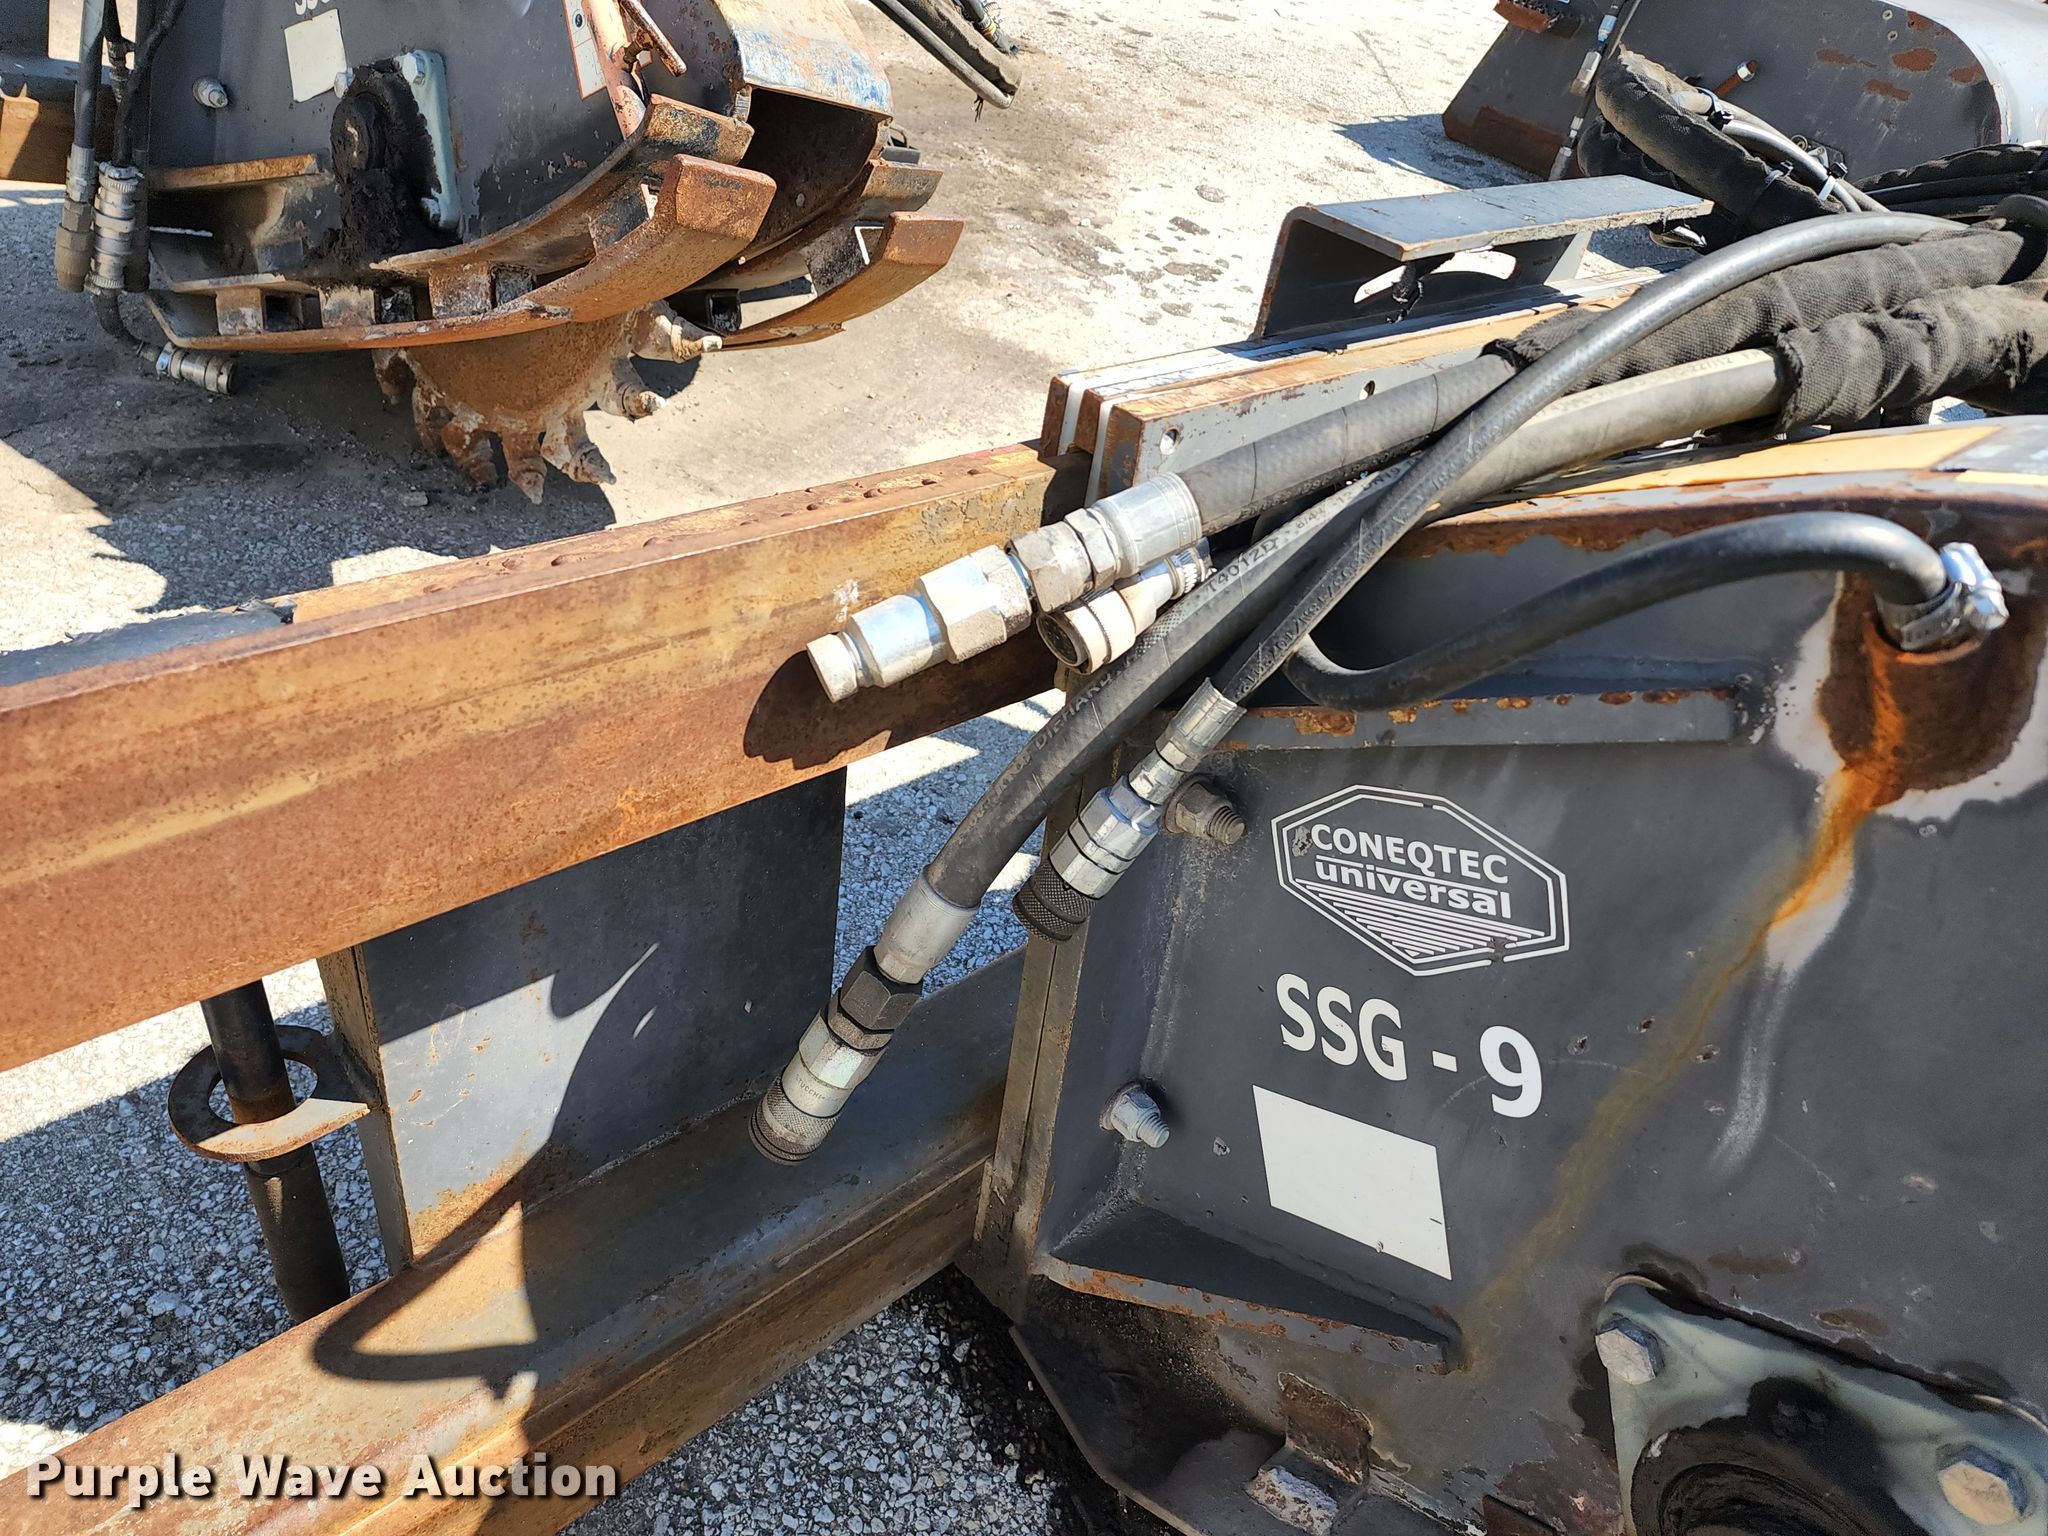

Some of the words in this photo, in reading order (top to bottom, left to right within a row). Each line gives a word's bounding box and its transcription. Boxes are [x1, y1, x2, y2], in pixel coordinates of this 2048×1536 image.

[1311, 824, 1509, 884] CONEQTEC
[1314, 861, 1512, 919] universal
[1276, 973, 1408, 1082] SSG
[1479, 1025, 1543, 1119] 9
